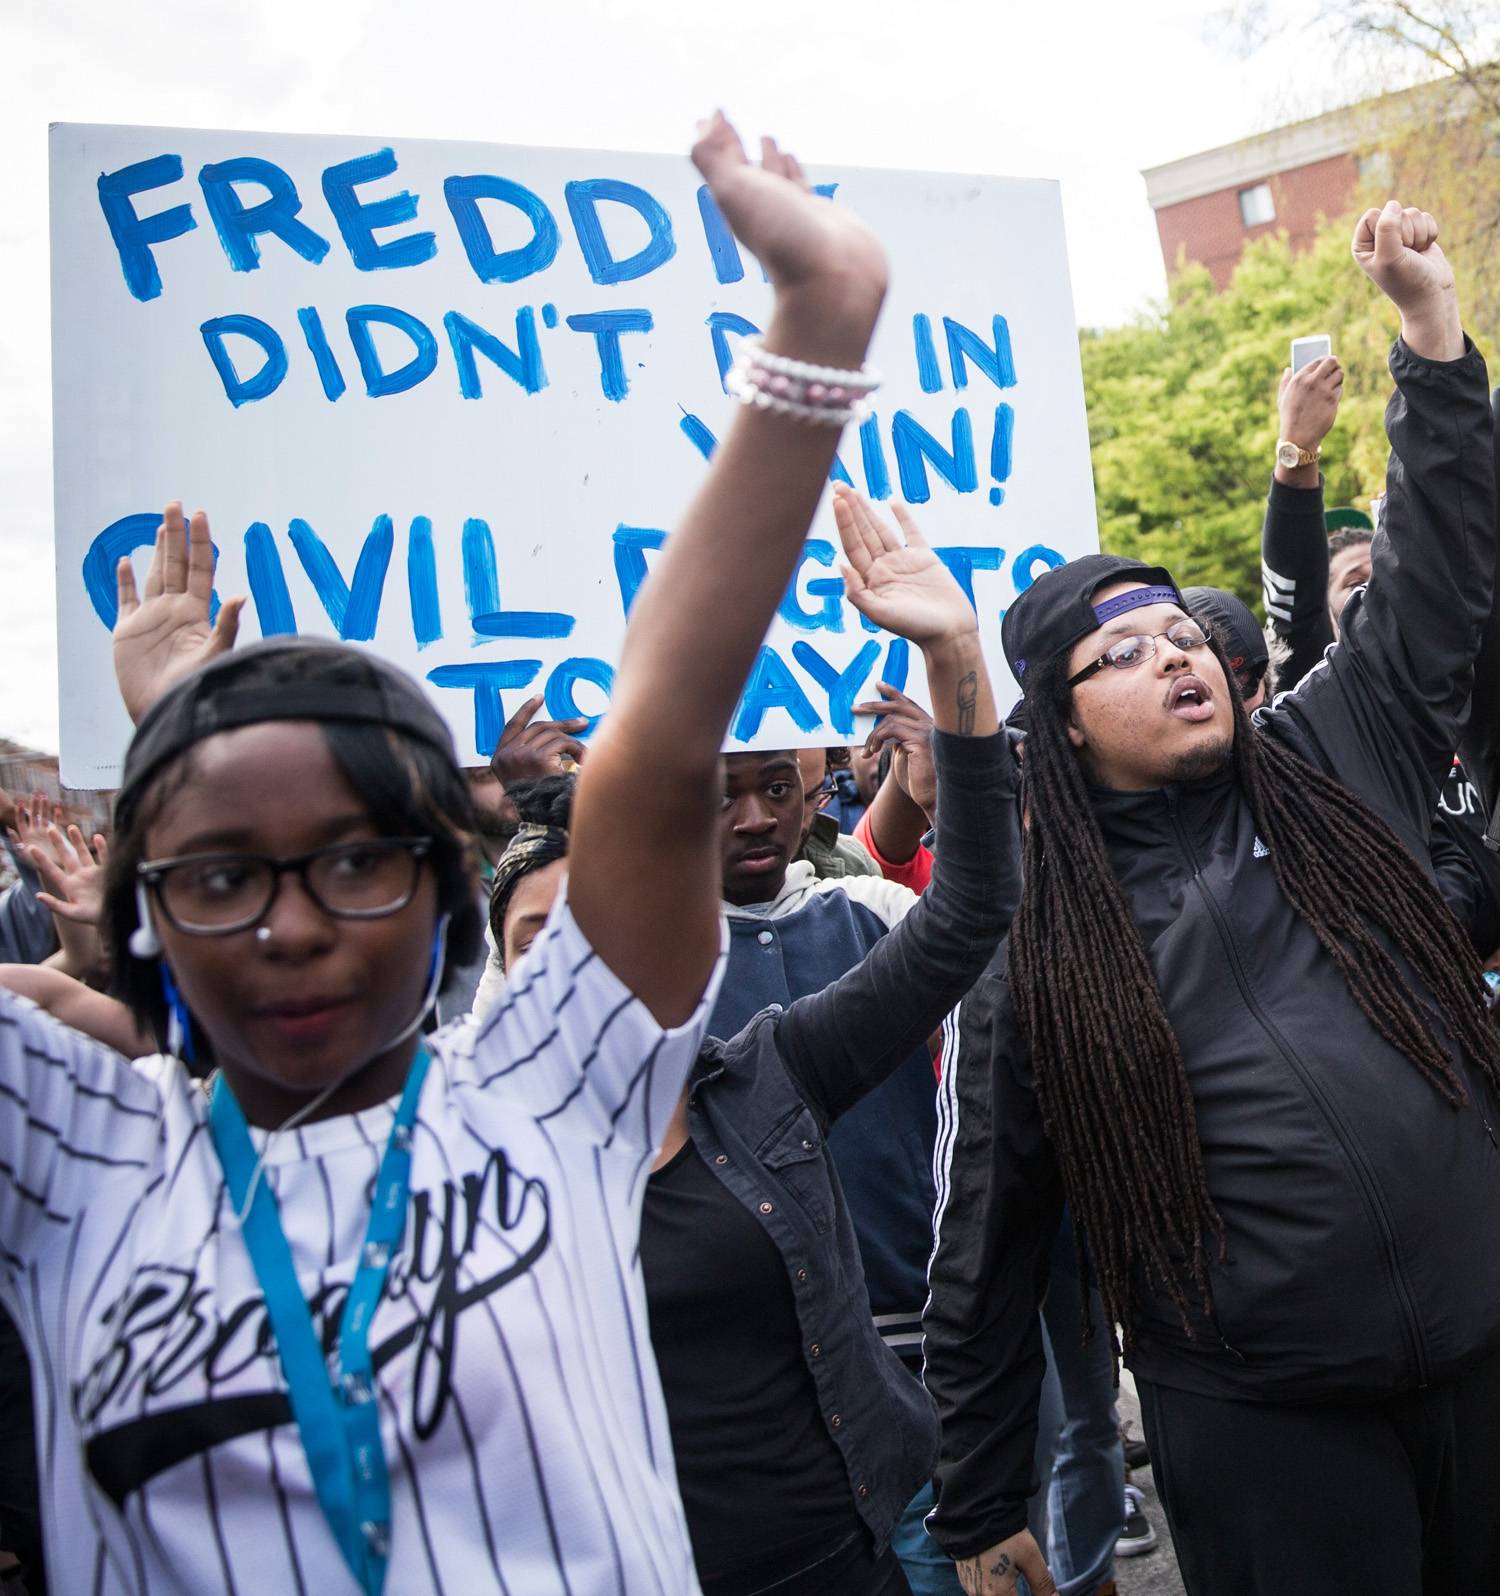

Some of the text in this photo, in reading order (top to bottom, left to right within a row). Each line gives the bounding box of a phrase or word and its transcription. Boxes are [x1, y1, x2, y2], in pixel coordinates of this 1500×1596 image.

[97, 147, 839, 302] FREDDI
[201, 303, 654, 406] DIDN'T
[912, 312, 1018, 394] IN
[678, 402, 1015, 506] IN!
[82, 512, 576, 652] CIVIL
[426, 638, 909, 757] TOAY!
